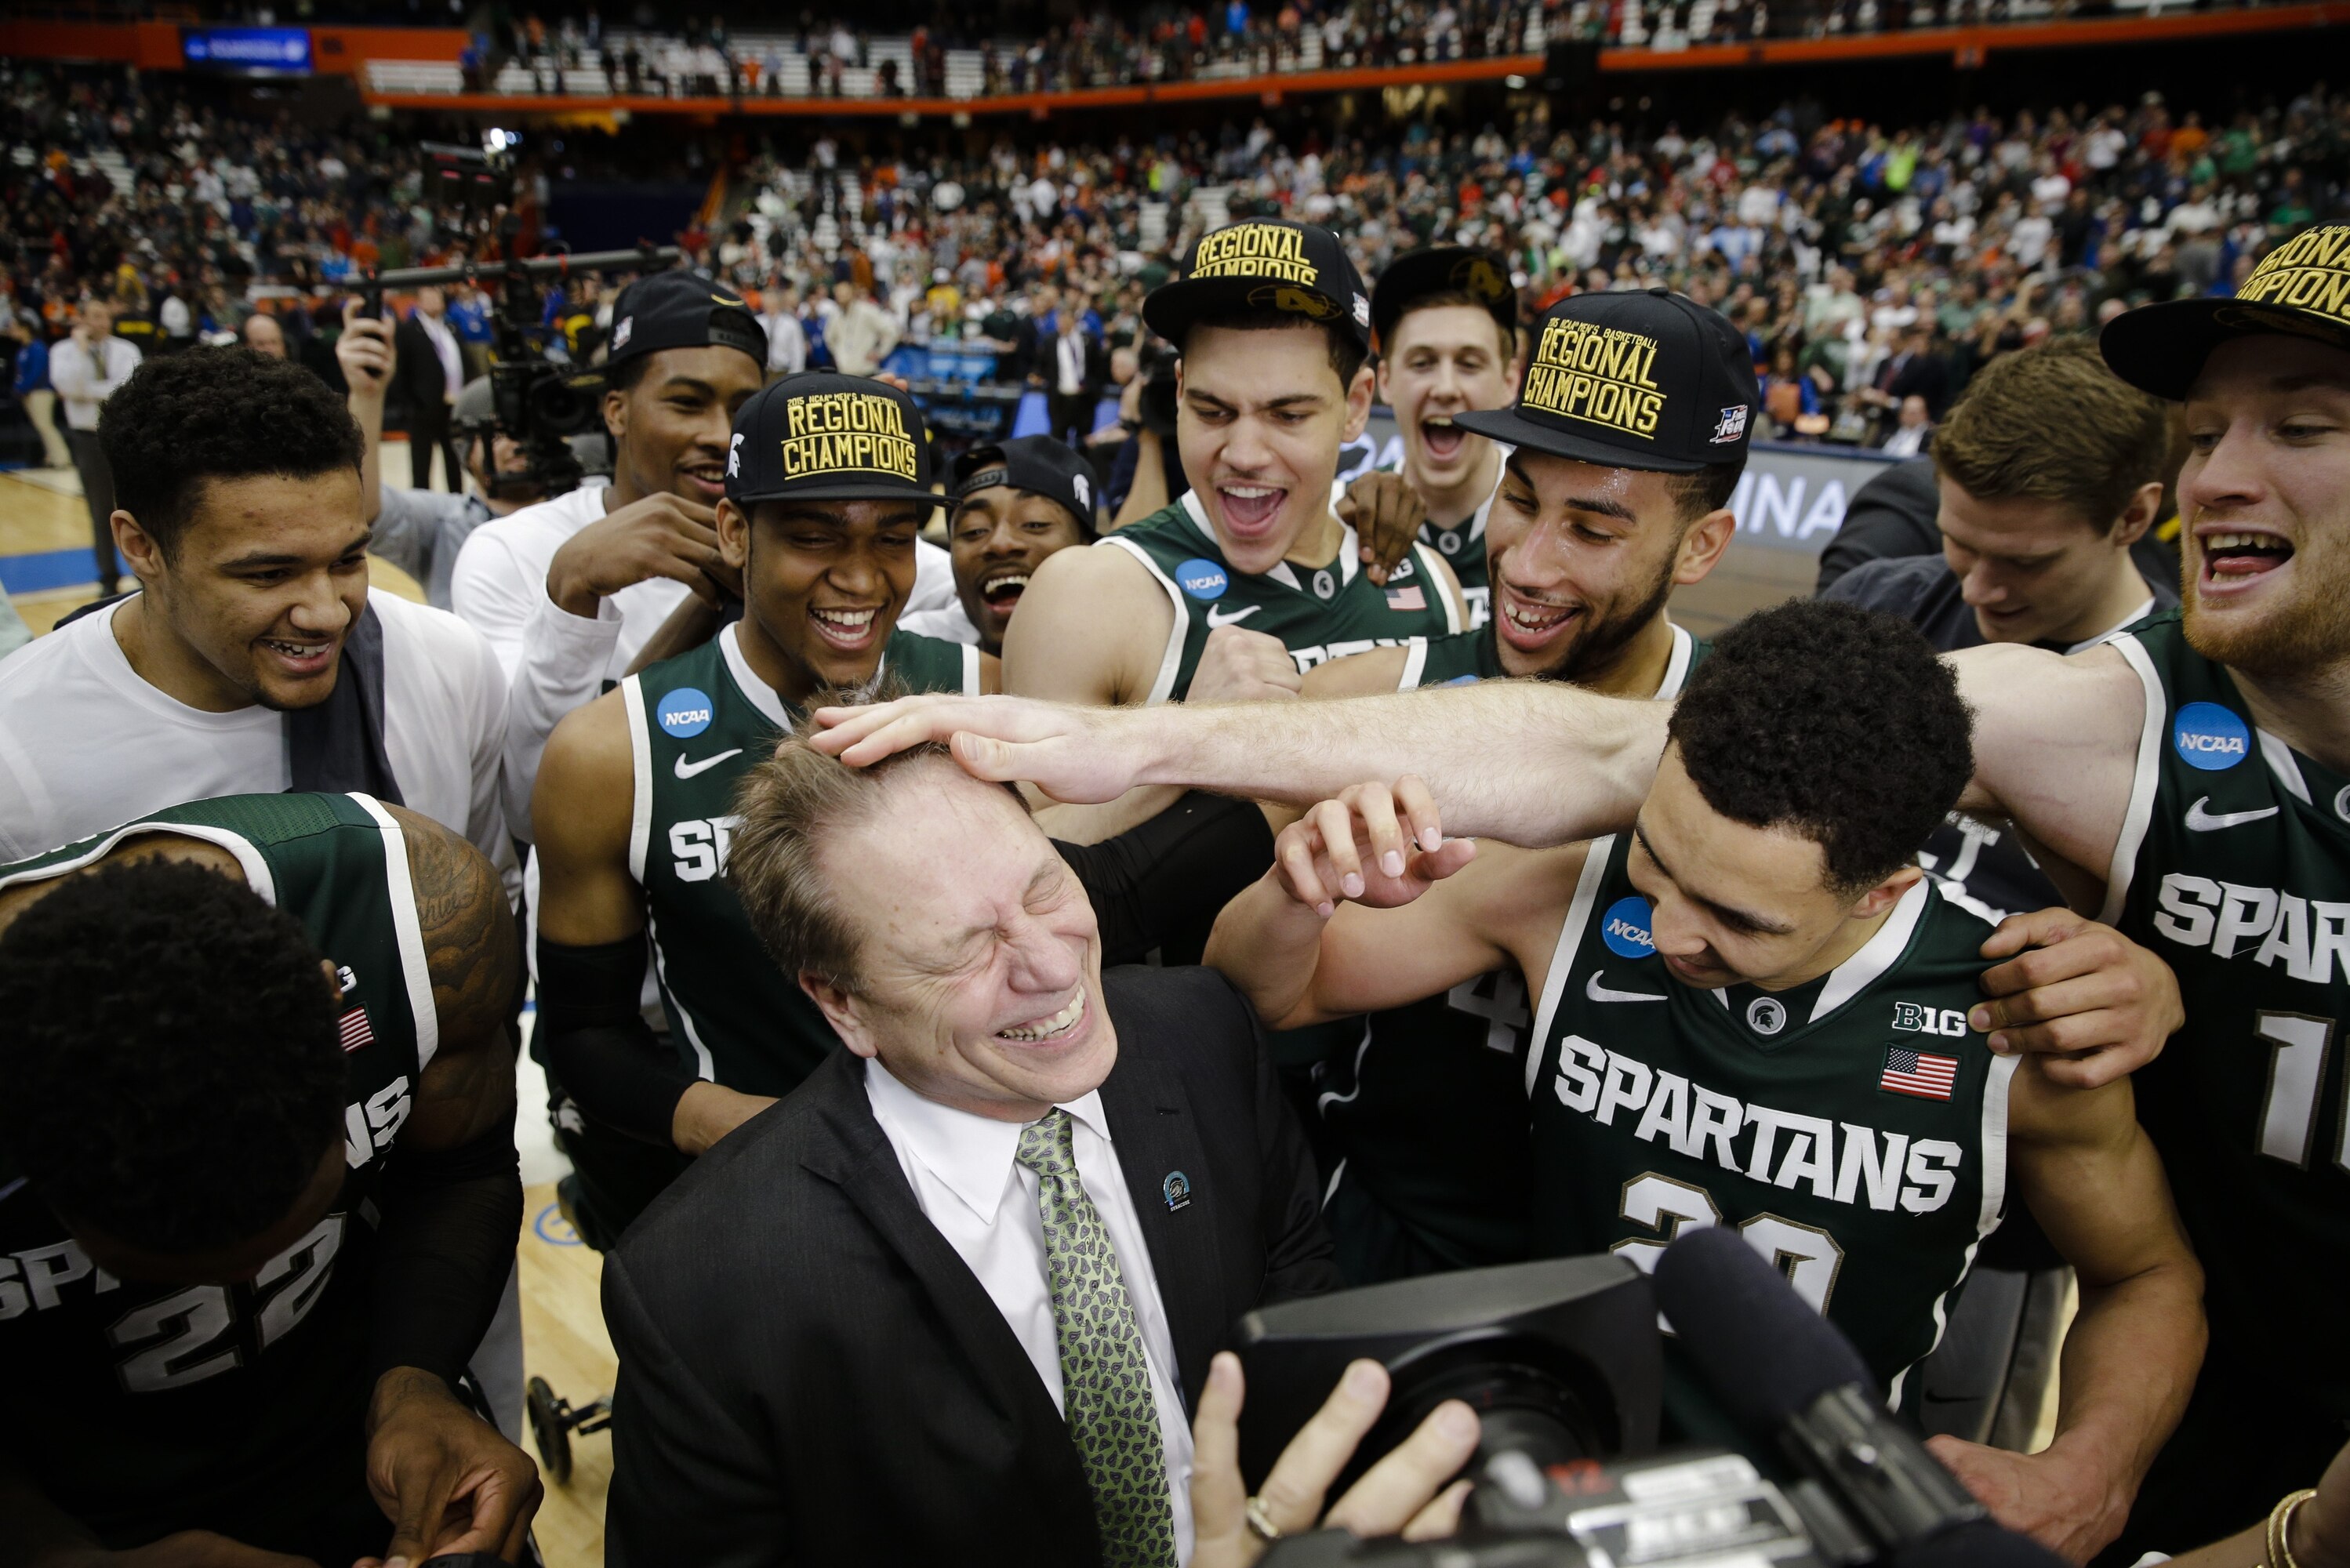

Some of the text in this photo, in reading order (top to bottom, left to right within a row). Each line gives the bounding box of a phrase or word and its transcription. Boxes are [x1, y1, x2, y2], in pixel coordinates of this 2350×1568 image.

[1196, 229, 1310, 270] REGIONAL
[1578, 321, 1600, 335] MEN'S
[1603, 328, 1658, 350] BASKETBALL
[1537, 327, 1658, 390] REGIONAL
[787, 396, 805, 407] 2015
[834, 392, 858, 401] MEN'S
[860, 394, 899, 408] BASKETBALL
[787, 400, 911, 441] REGIONAL
[1524, 366, 1662, 434] CHAMPIONS
[783, 434, 917, 477] CHAMPIONS
[1185, 573, 1226, 590] NCAA
[665, 709, 710, 726] NCAA
[2181, 732, 2245, 754] NCAA
[2153, 873, 2350, 985] SPAR
[1554, 1034, 1963, 1214] SPARTANS
[104, 1211, 347, 1394] 22
